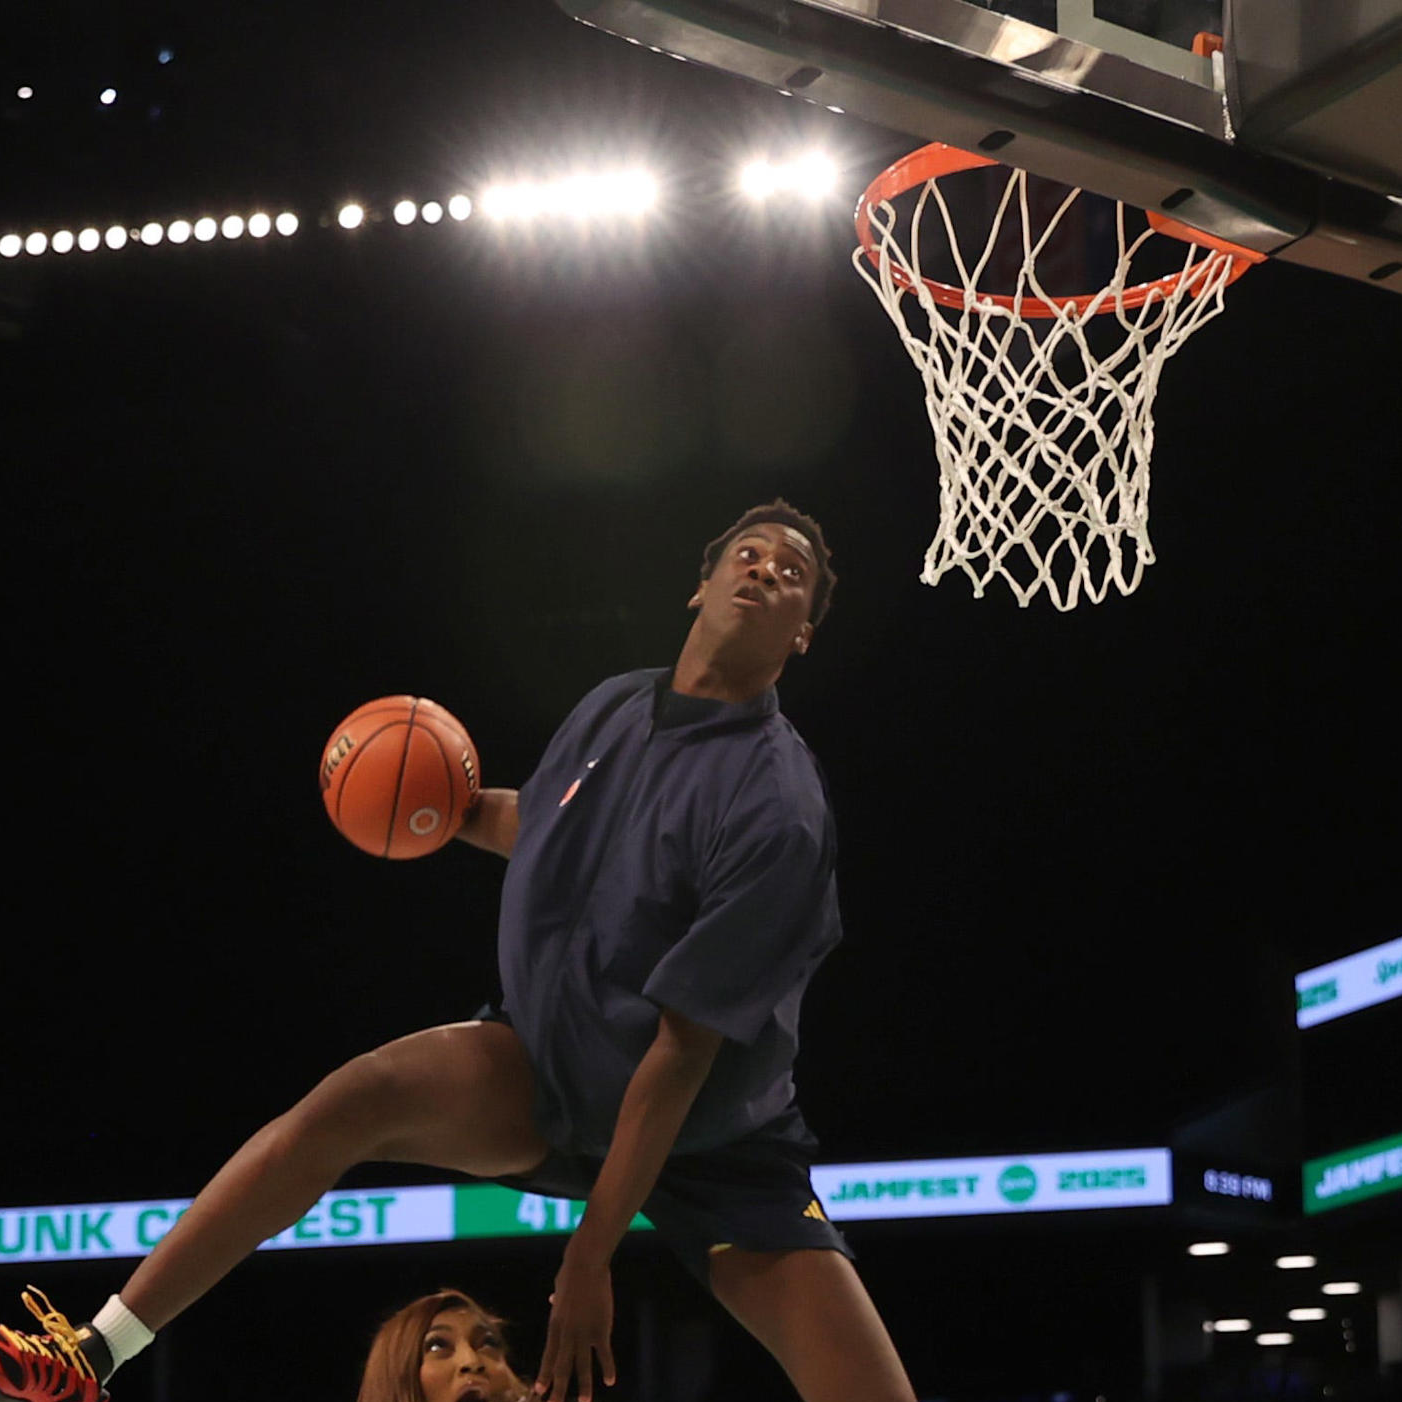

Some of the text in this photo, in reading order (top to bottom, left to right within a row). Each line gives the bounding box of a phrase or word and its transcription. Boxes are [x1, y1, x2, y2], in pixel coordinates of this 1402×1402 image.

[828, 1173, 981, 1204] JAMFEST
[1056, 1165, 1149, 1193] 2025
[135, 1194, 398, 1249] CEST
